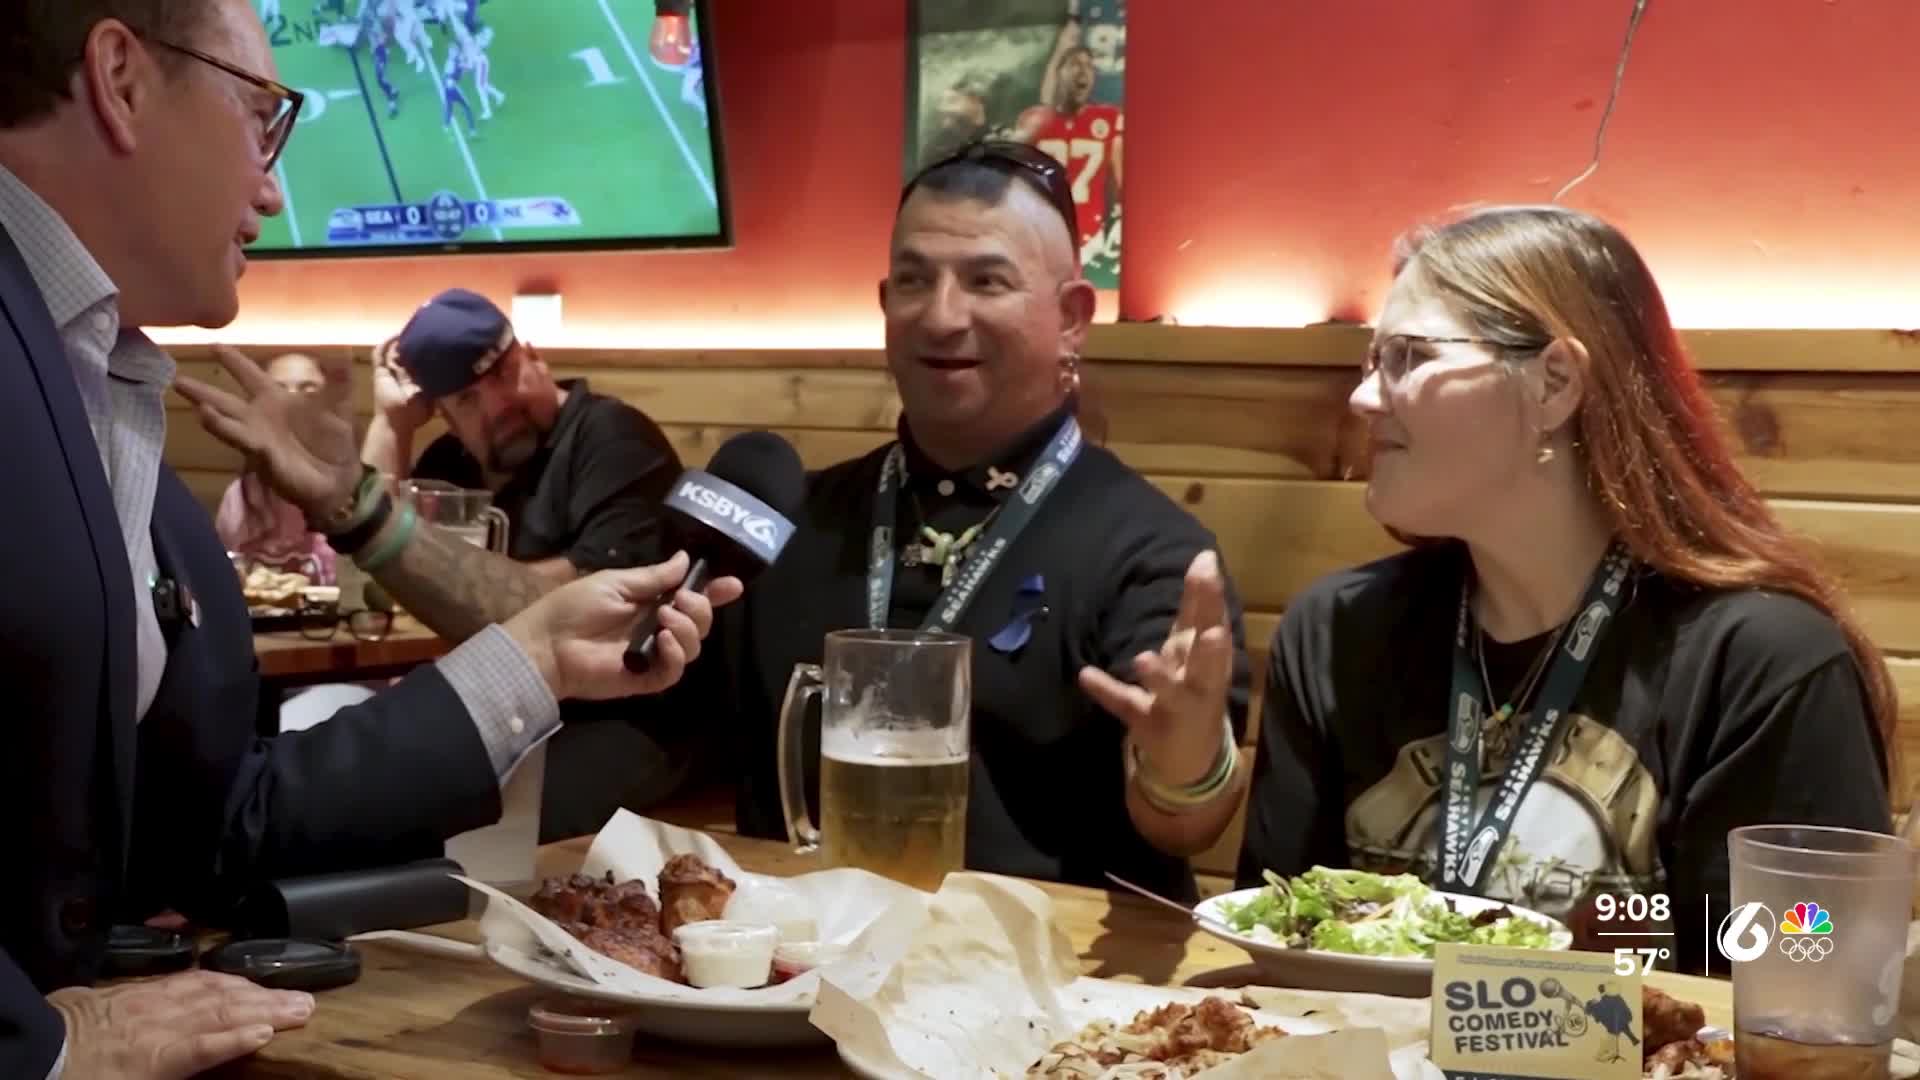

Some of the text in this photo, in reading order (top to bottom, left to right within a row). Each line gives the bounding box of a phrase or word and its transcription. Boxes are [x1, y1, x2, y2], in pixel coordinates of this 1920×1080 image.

[405, 206, 421, 226] 0
[473, 203, 488, 223] 0
[679, 481, 751, 524] KSBY
[941, 537, 1006, 624] SEAHAWKS
[1495, 709, 1559, 821] SEAHAWKS
[1443, 762, 1466, 883] SEAHAWKS
[1445, 977, 1536, 1011] SLO
[1449, 1010, 1553, 1033] COMEDY
[1455, 1029, 1570, 1054] FESTIVAL
